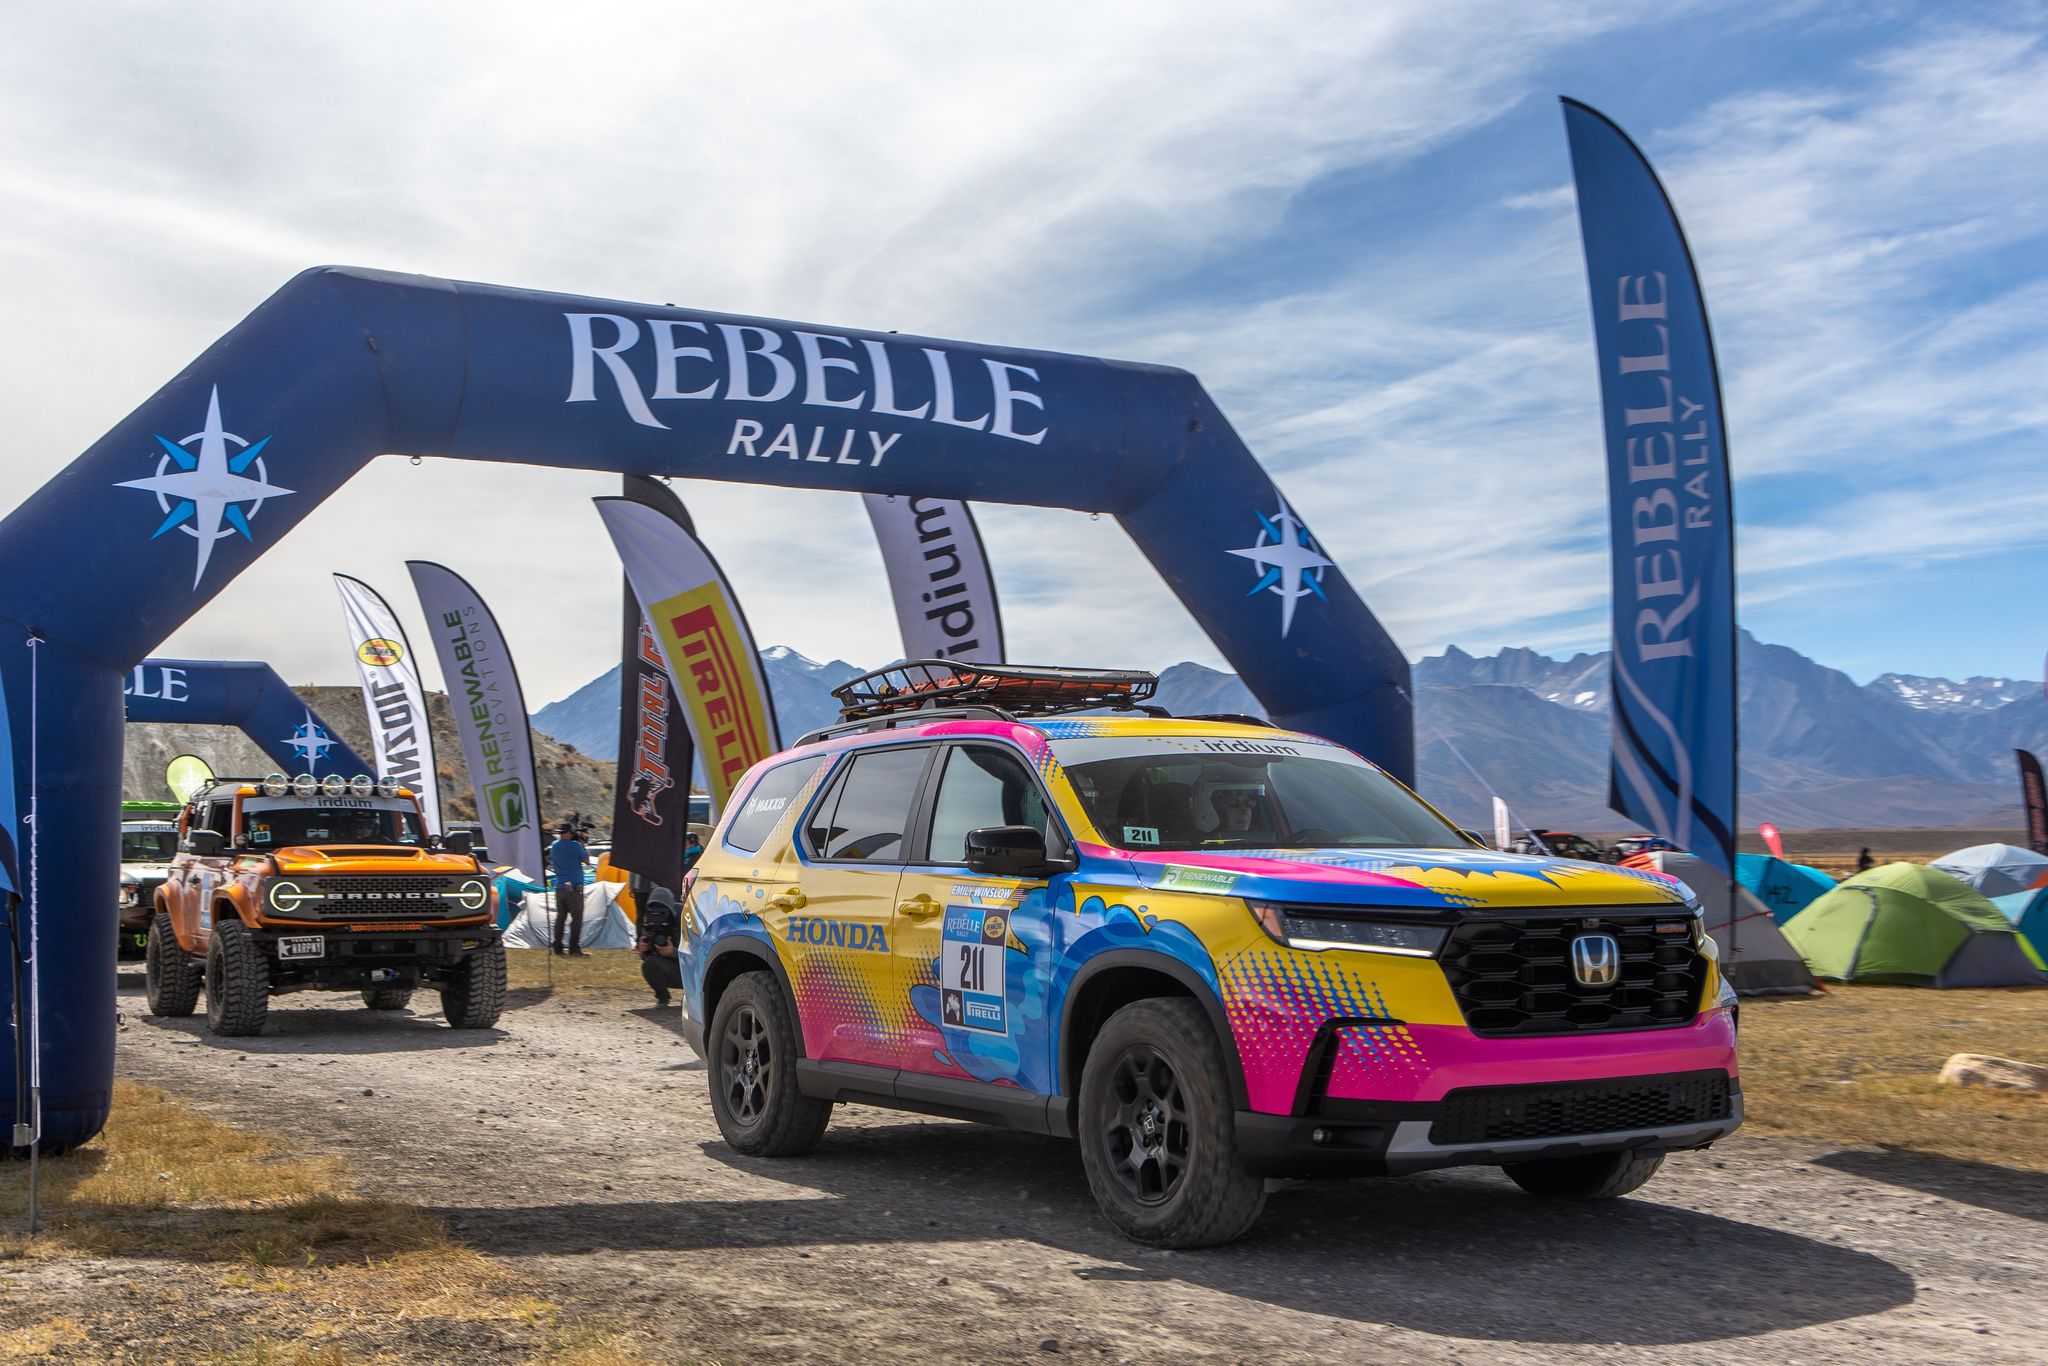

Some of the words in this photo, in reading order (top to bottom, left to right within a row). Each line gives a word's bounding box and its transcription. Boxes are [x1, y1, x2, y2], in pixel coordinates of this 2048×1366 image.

[563, 312, 1049, 445] REBELLE
[726, 418, 902, 467] RALLY
[1678, 395, 1712, 530] RALLY
[1617, 270, 1701, 663] REBELLE
[909, 496, 980, 660] idium
[442, 609, 505, 777] RENEWABLE
[463, 605, 518, 772] INNOVATIONS
[670, 605, 761, 798] PIRELL
[634, 672, 670, 785] TOTAL
[1200, 739, 1301, 756] iridium
[318, 797, 373, 808] iridium
[755, 797, 787, 812] MAXXIS
[1131, 829, 1153, 842] 211
[327, 892, 440, 900] BRONCO
[951, 884, 974, 897] EMILY
[974, 886, 1013, 899] WINSLOW
[1182, 871, 1236, 884] RENEWABLE
[786, 916, 890, 953] HONDA
[947, 917, 981, 934] REBELLE
[960, 945, 985, 991] 211
[966, 1001, 1001, 1021] PIRELLI
